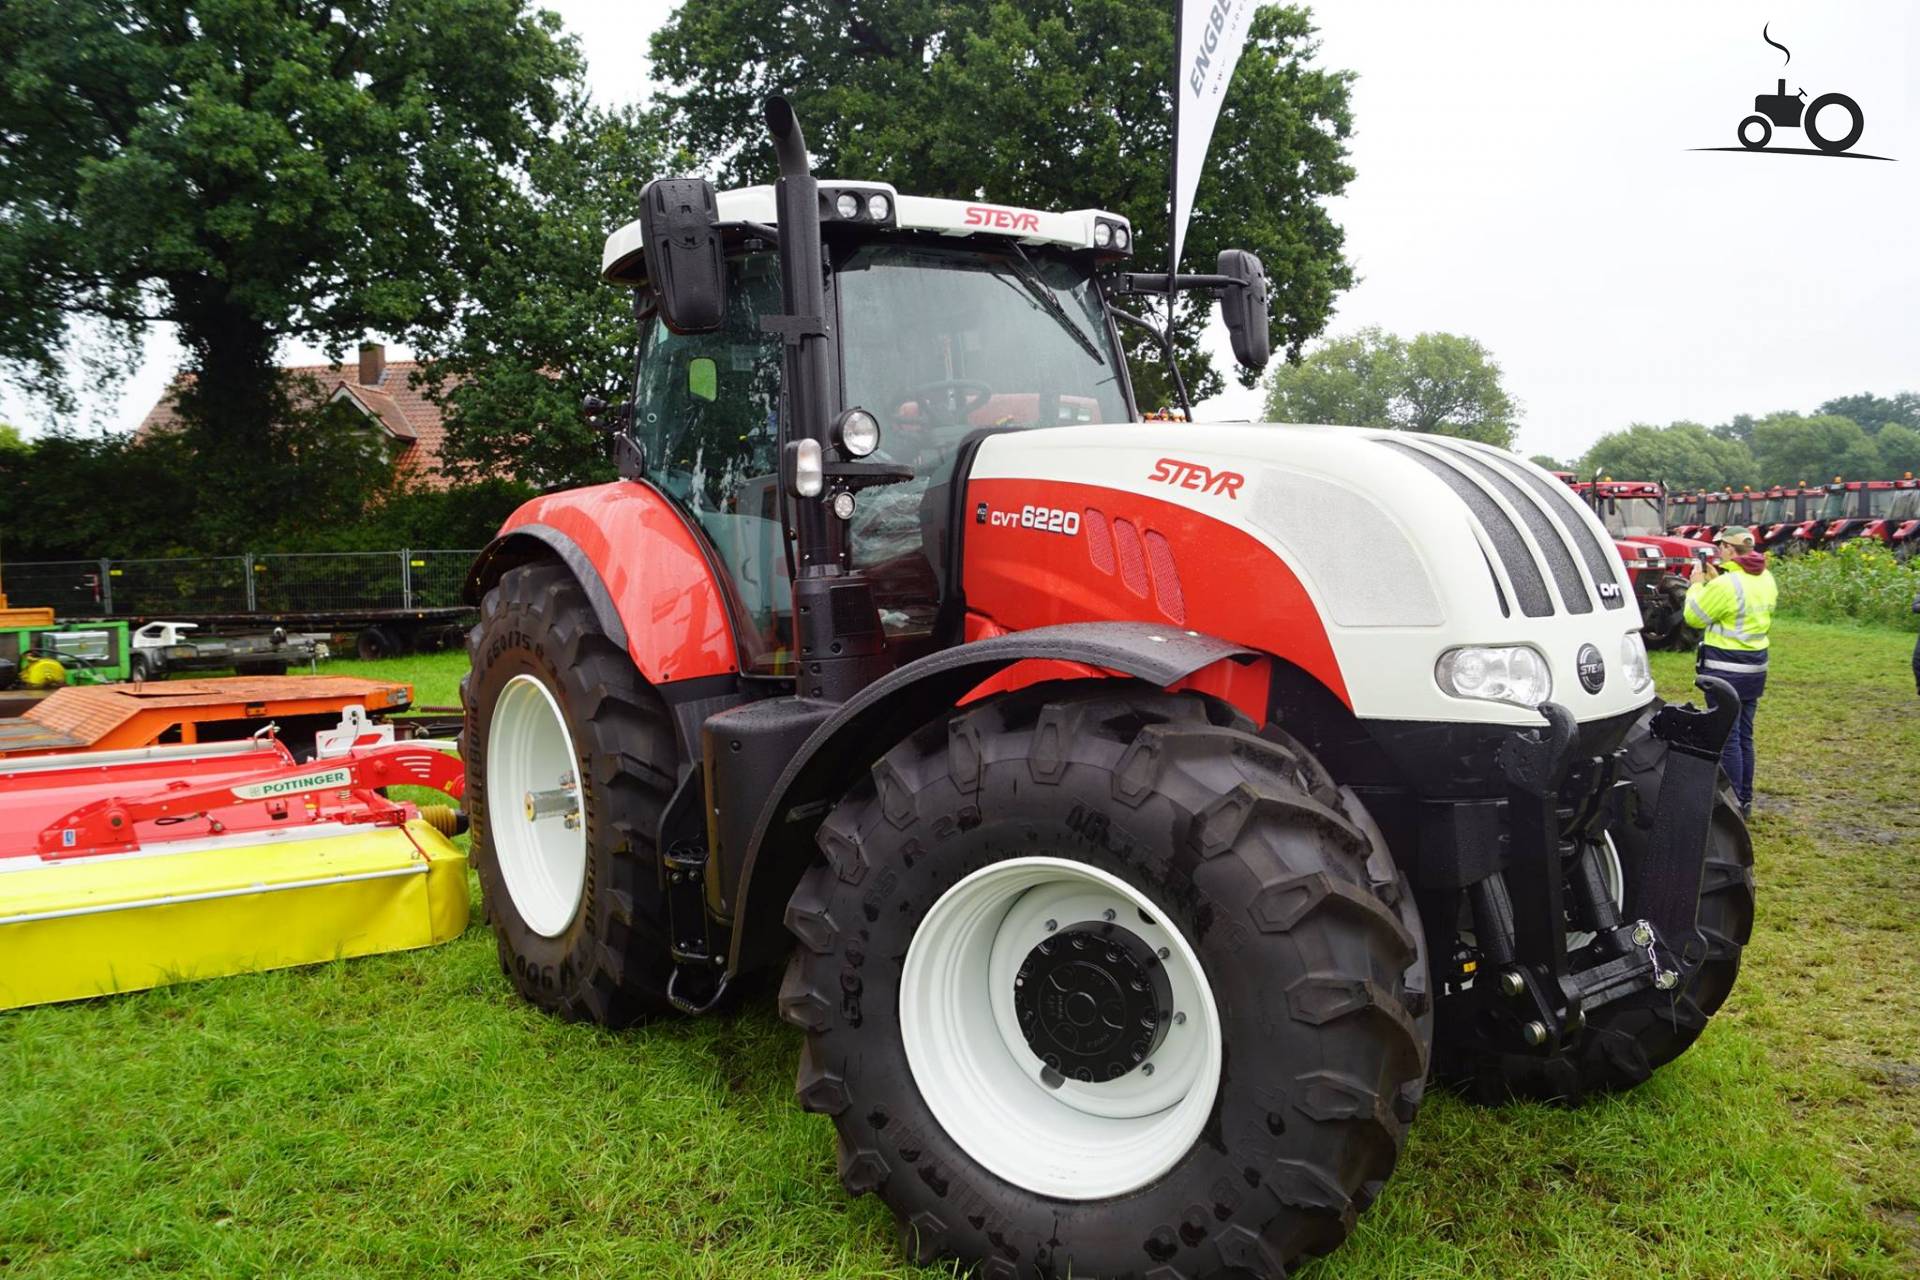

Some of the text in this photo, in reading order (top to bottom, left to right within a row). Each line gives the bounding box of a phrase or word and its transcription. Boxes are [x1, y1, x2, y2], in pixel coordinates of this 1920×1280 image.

[964, 206, 1039, 232] STEYR
[1147, 457, 1245, 500] STEYR
[991, 511, 1020, 528] CVT
[1021, 504, 1080, 536] 6220
